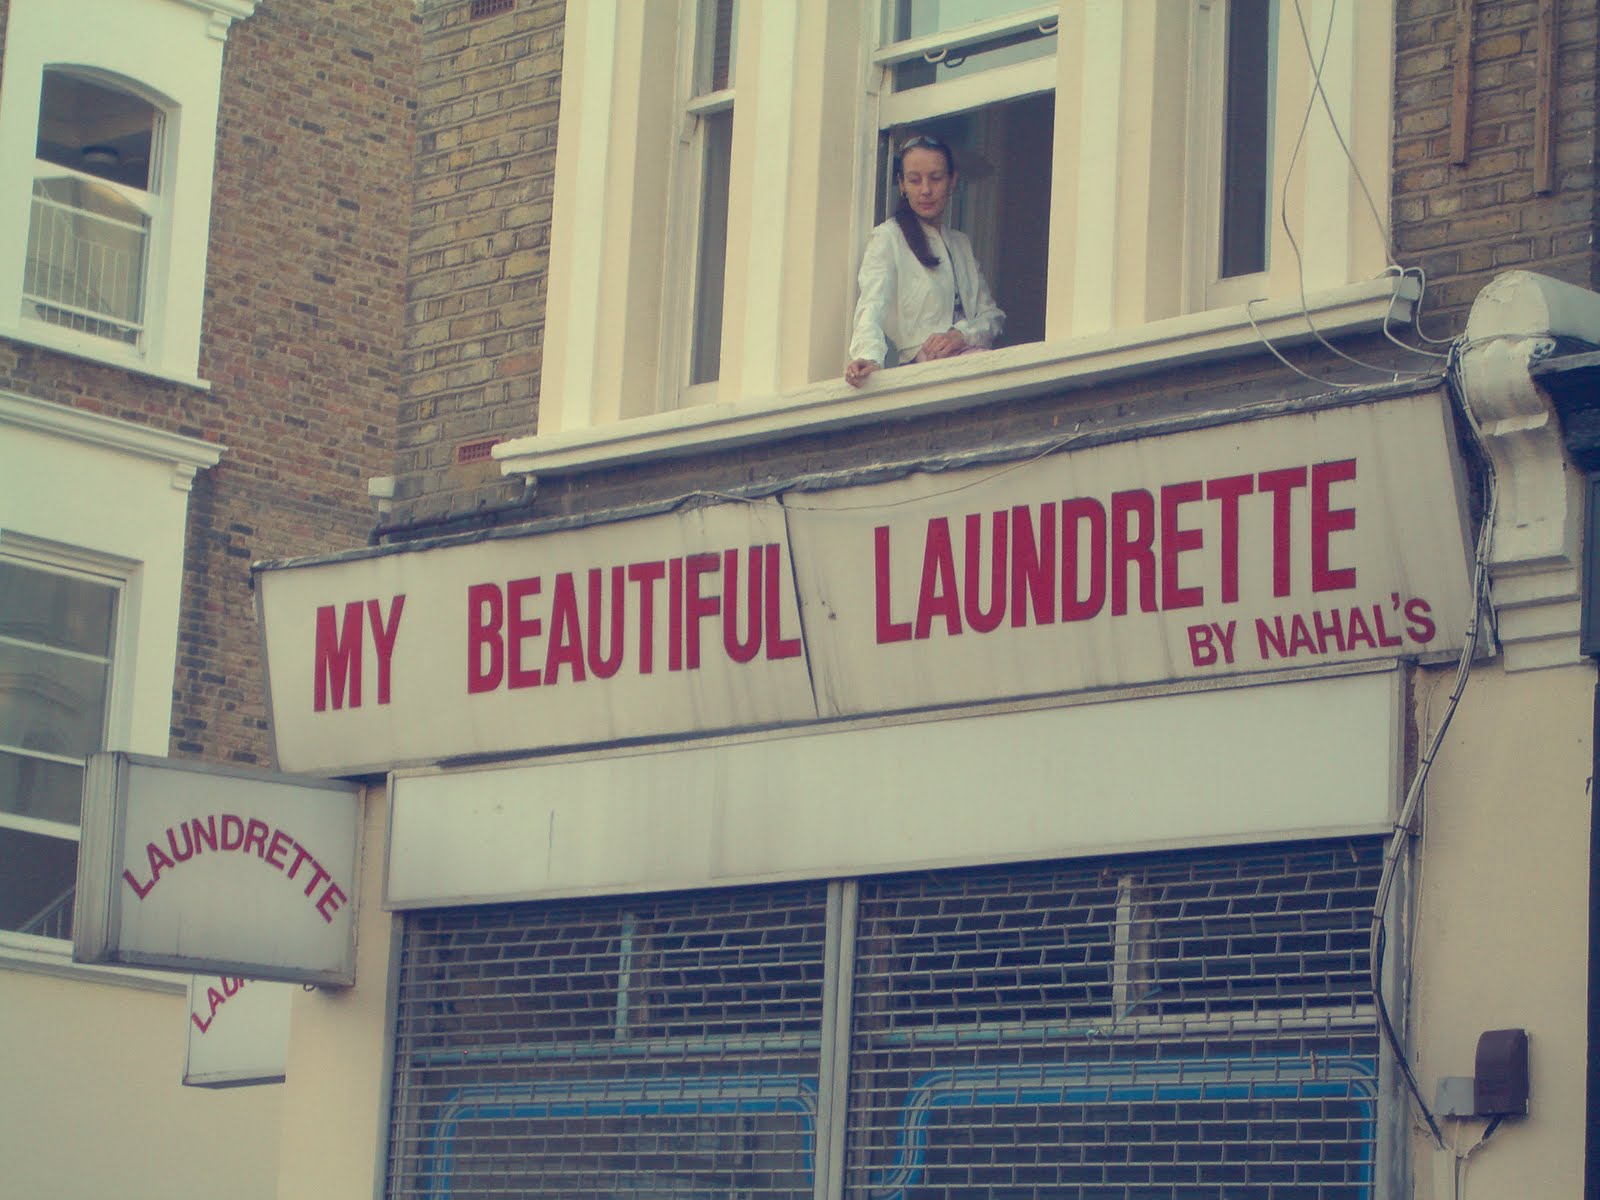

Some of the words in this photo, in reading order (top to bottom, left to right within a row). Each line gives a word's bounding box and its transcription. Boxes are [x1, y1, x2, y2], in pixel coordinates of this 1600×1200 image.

[314, 594, 406, 713] MY
[467, 543, 801, 695] BEAUTIFUL
[873, 457, 1357, 645] LAUNDRETTE
[1187, 620, 1237, 667] BY
[1256, 592, 1436, 660] NAHAL'S
[122, 813, 348, 924] LAUNDRETTE
[191, 975, 254, 1034] LAU
